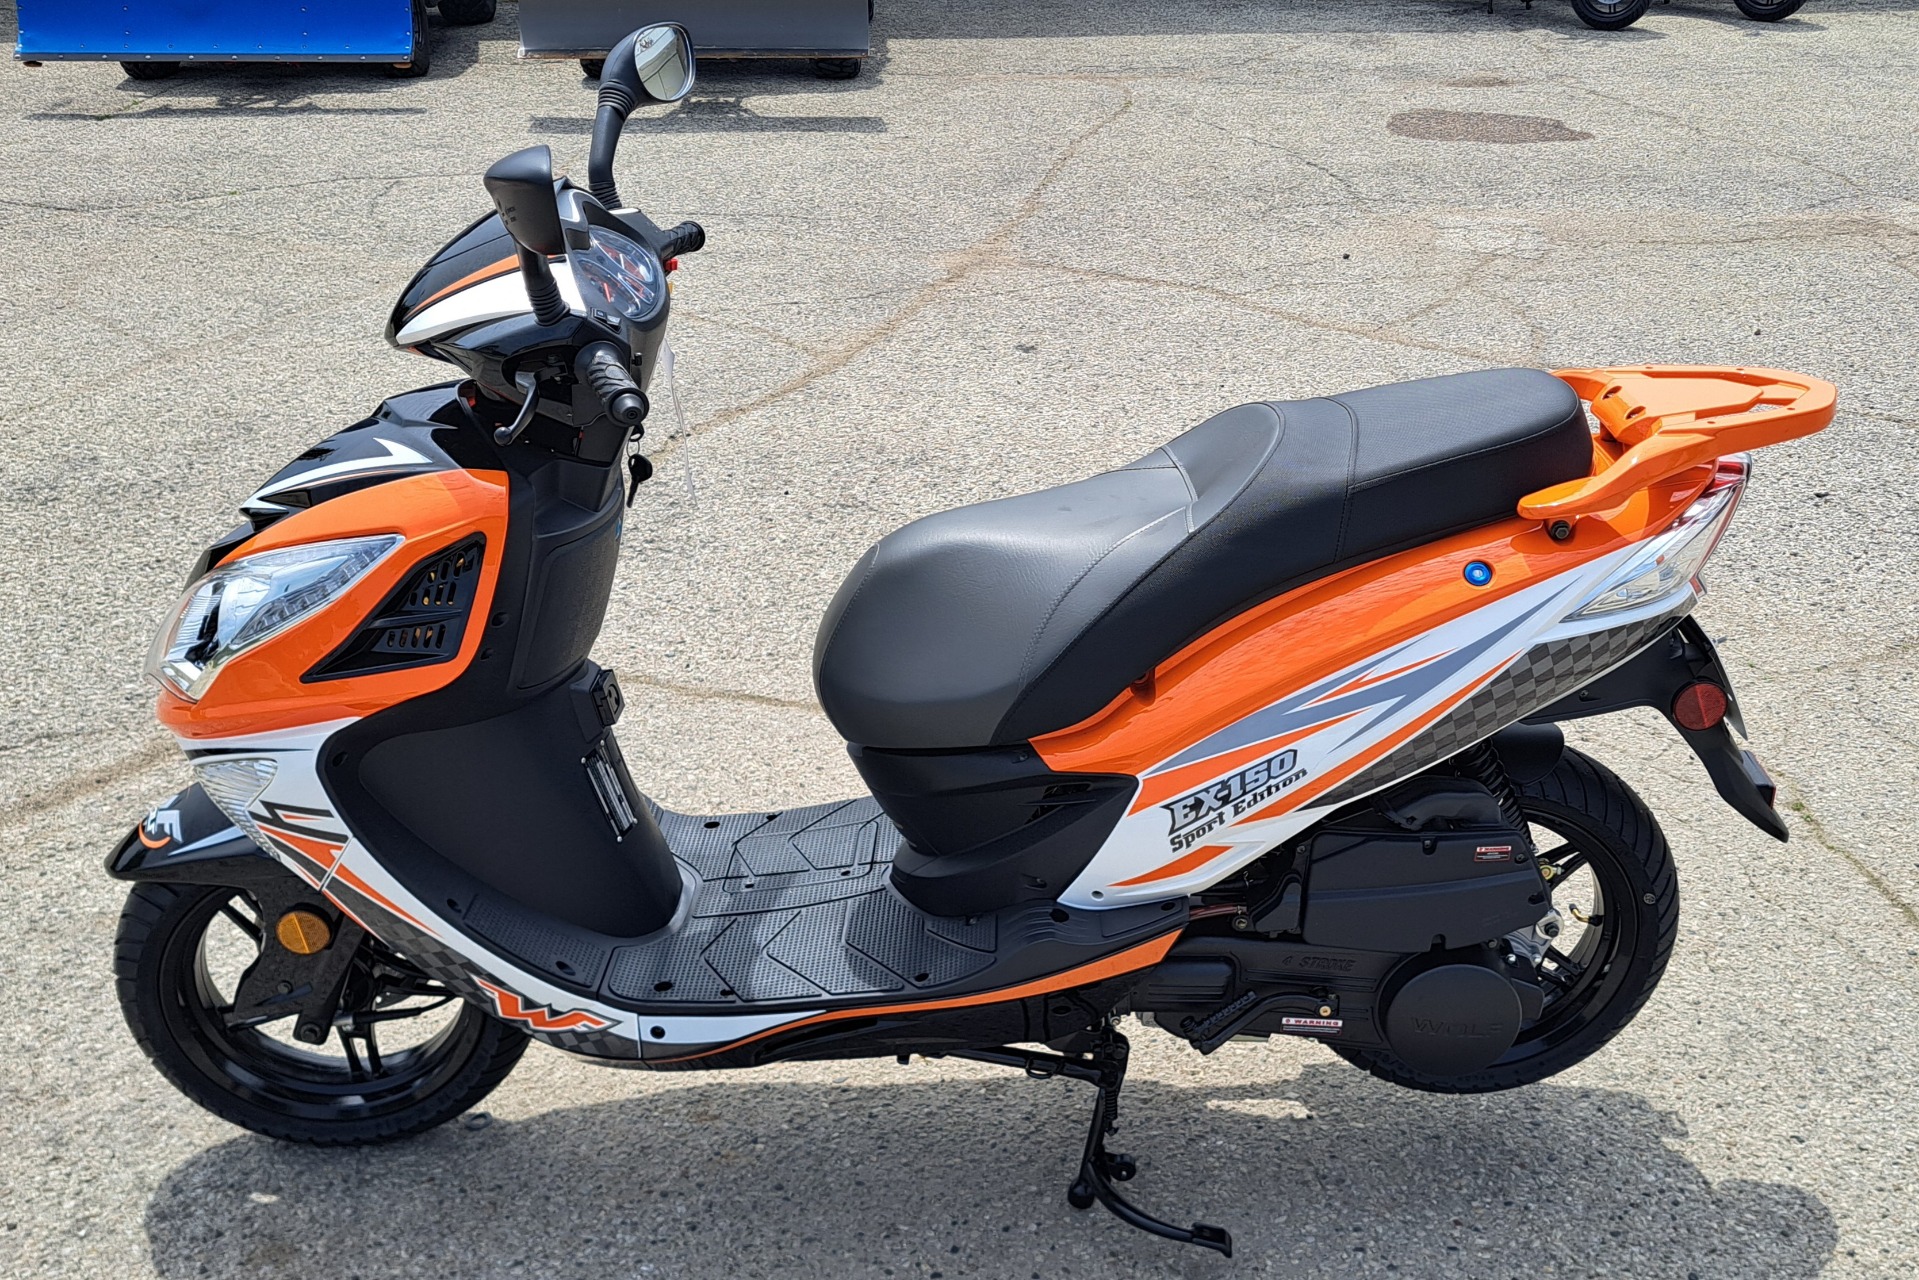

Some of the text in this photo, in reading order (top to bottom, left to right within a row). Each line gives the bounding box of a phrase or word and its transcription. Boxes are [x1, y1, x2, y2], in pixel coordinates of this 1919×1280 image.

[1170, 767, 1309, 853] Sport Edition
[1299, 956, 1356, 972] STROKE
[1413, 1017, 1502, 1037] WOLF
